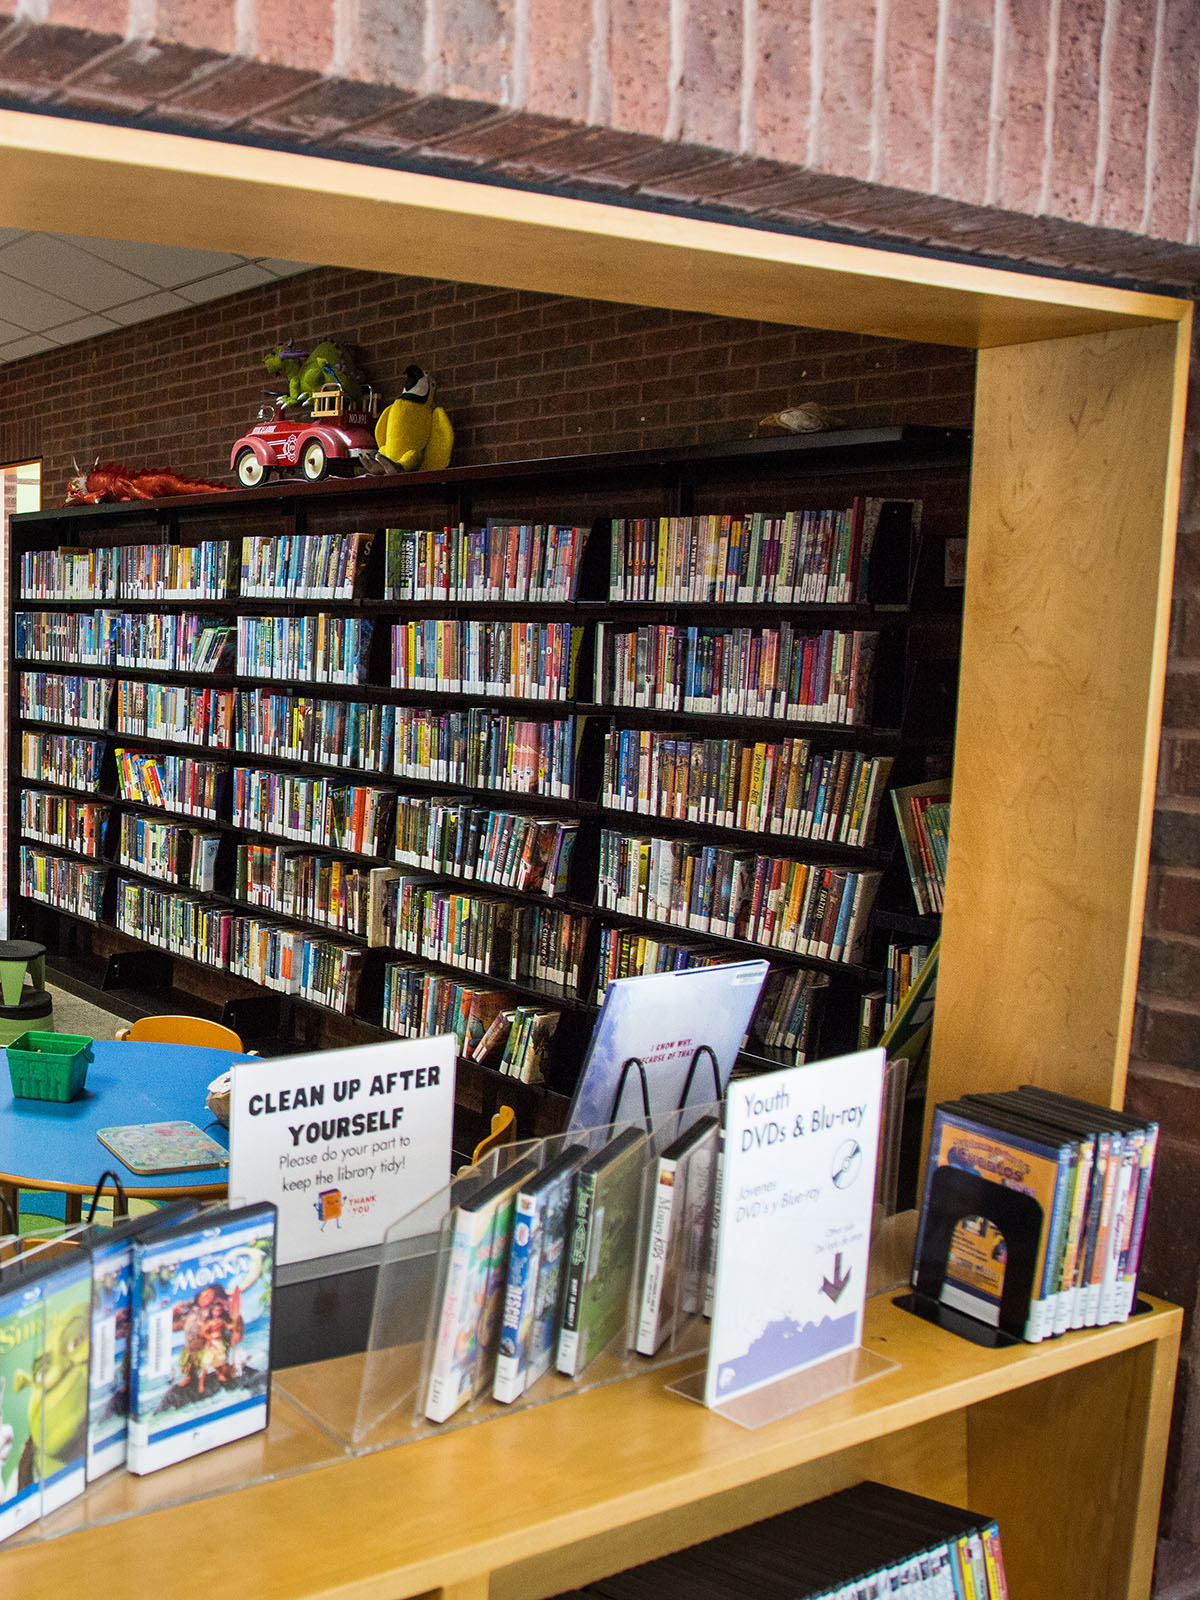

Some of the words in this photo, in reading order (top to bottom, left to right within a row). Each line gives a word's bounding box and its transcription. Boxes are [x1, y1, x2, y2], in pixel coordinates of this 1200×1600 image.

[753, 753, 762, 782] WORLD
[816, 889, 828, 919] FRAZZLED
[541, 928, 549, 954] Click'd
[656, 1041, 675, 1052] KNOW
[667, 1053, 676, 1061] OF
[248, 1084, 325, 1117] CLEAN
[333, 1079, 361, 1103] UP
[369, 1065, 441, 1097] AFTER
[743, 1086, 790, 1118] Youth
[288, 1107, 404, 1147] YOURSELF
[741, 1122, 786, 1153] DVDs
[792, 1113, 804, 1137] &
[810, 1103, 867, 1132] Blu-ray
[279, 1152, 318, 1170] Please
[321, 1145, 337, 1162] do
[341, 1145, 367, 1164] your
[372, 1138, 396, 1154] part
[400, 1135, 411, 1147] to
[282, 1175, 312, 1193] keep
[315, 1169, 333, 1186] the
[338, 1162, 376, 1182] library
[380, 1157, 406, 1174] tidy!
[349, 1195, 376, 1207] THANK
[352, 1204, 369, 1214] YOU
[654, 1195, 672, 1236] Money
[174, 1257, 248, 1294] MOANA
[504, 1285, 523, 1330] RESCUE
